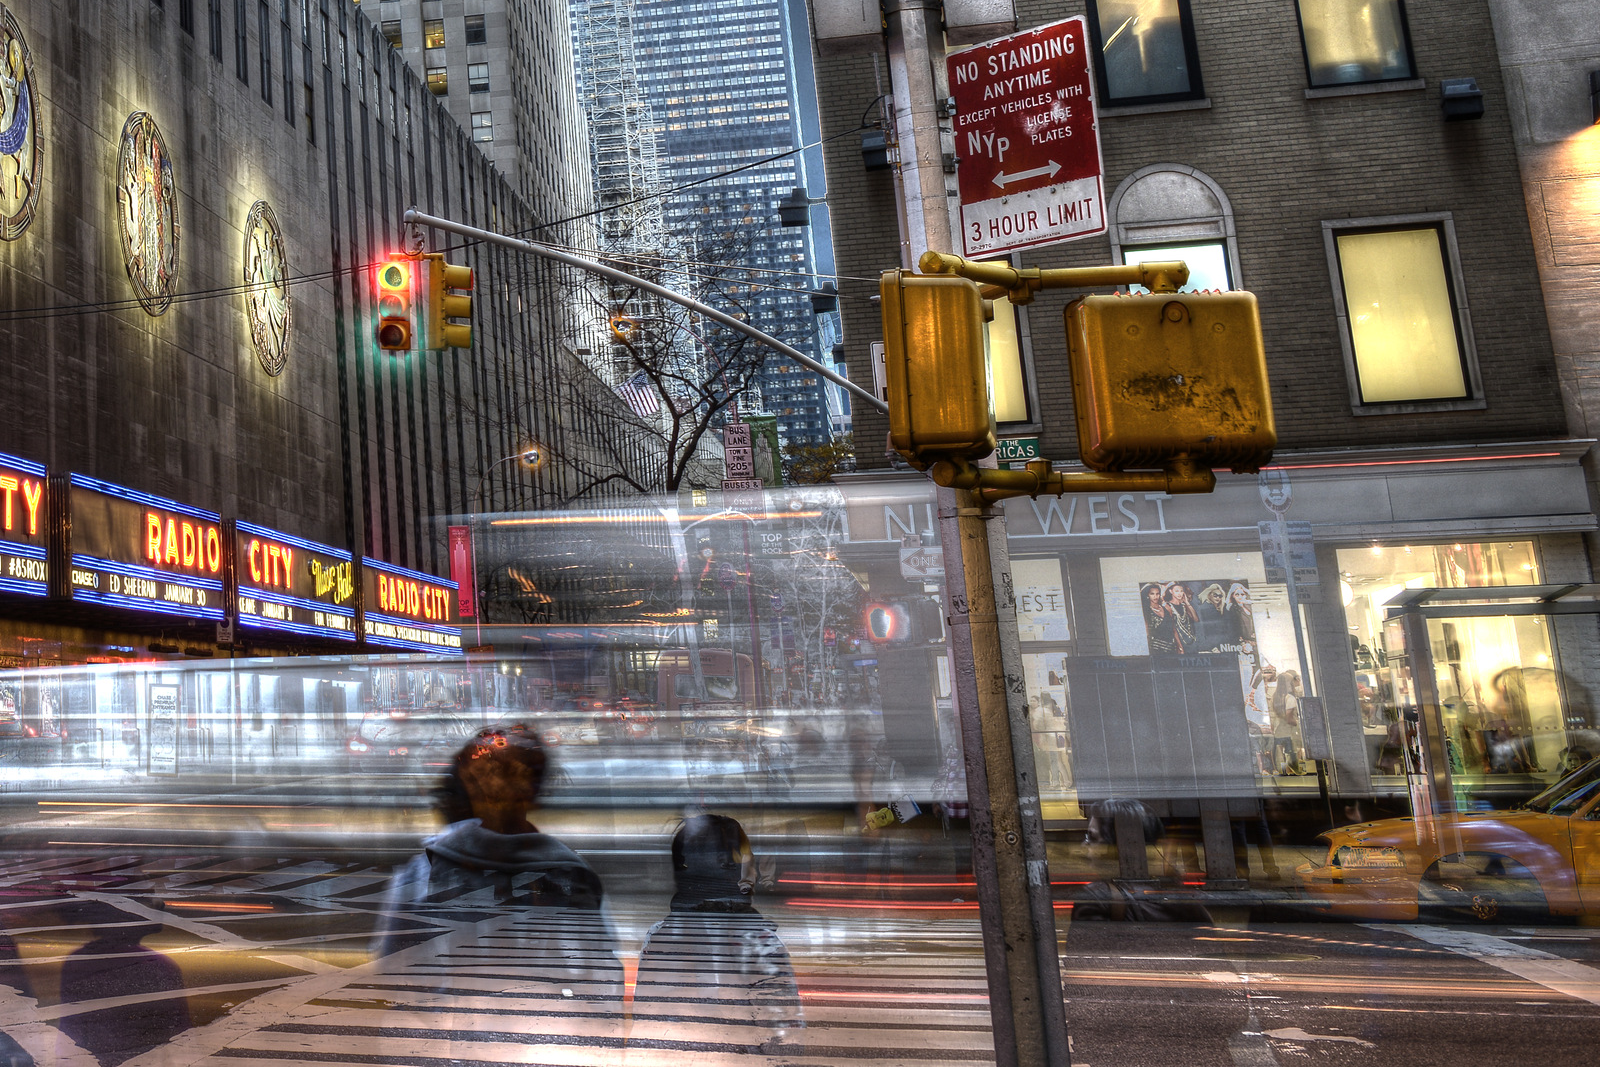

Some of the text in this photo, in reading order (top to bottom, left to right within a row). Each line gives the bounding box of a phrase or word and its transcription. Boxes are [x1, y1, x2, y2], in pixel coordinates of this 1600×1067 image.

[956, 34, 1075, 84] NO STANDING
[984, 69, 1052, 100] ANYTIME
[959, 84, 1083, 126] EXCEPT VEHICLES WITH
[1027, 107, 1073, 128] LICENSE
[967, 129, 1010, 163] NYP
[1031, 126, 1073, 146] PLATES
[971, 198, 1093, 242] 3 HOUR LIMIT
[728, 437, 748, 445] LANE
[730, 426, 744, 434] BUS
[996, 446, 1034, 458] RICAS
[724, 482, 750, 490] BUSES
[1029, 493, 1172, 536] WEST
[146, 510, 221, 573] RADIO
[760, 534, 782, 542] TOP
[249, 539, 293, 589] CITY
[910, 556, 940, 567] ONE
[72, 570, 93, 587] CHASE
[110, 574, 206, 606] ED SHEERAN JANUARY 30
[379, 574, 450, 622] RADIO CITY
[1178, 657, 1212, 666] TITAN
